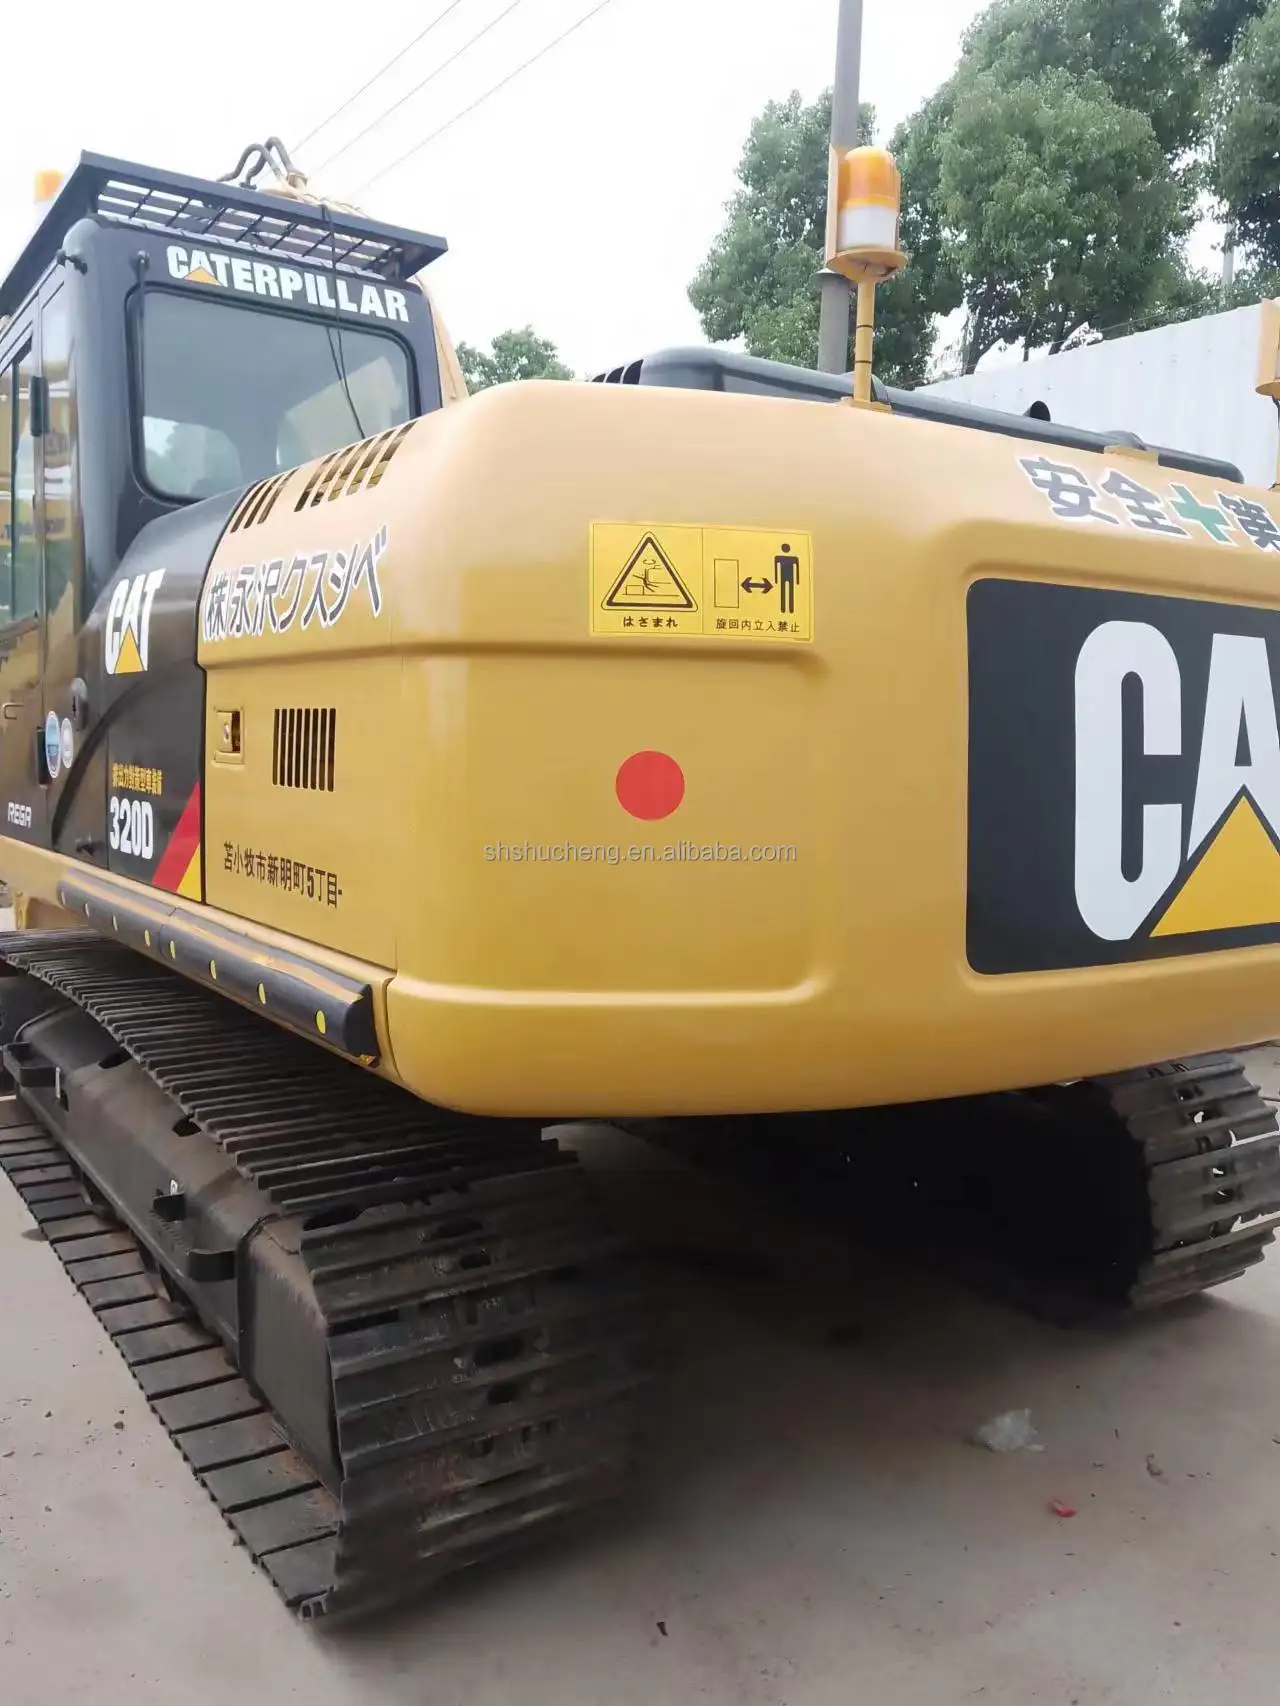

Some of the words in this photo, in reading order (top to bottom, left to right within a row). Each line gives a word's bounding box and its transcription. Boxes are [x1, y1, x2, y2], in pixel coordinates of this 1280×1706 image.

[166, 245, 410, 323] CATERPILLAR
[1018, 456, 1190, 537] 安全
[105, 567, 167, 675] CAT
[622, 615, 679, 629] はさまれ
[715, 617, 801, 633] 旋回内立入禁止
[109, 796, 153, 860] 320D
